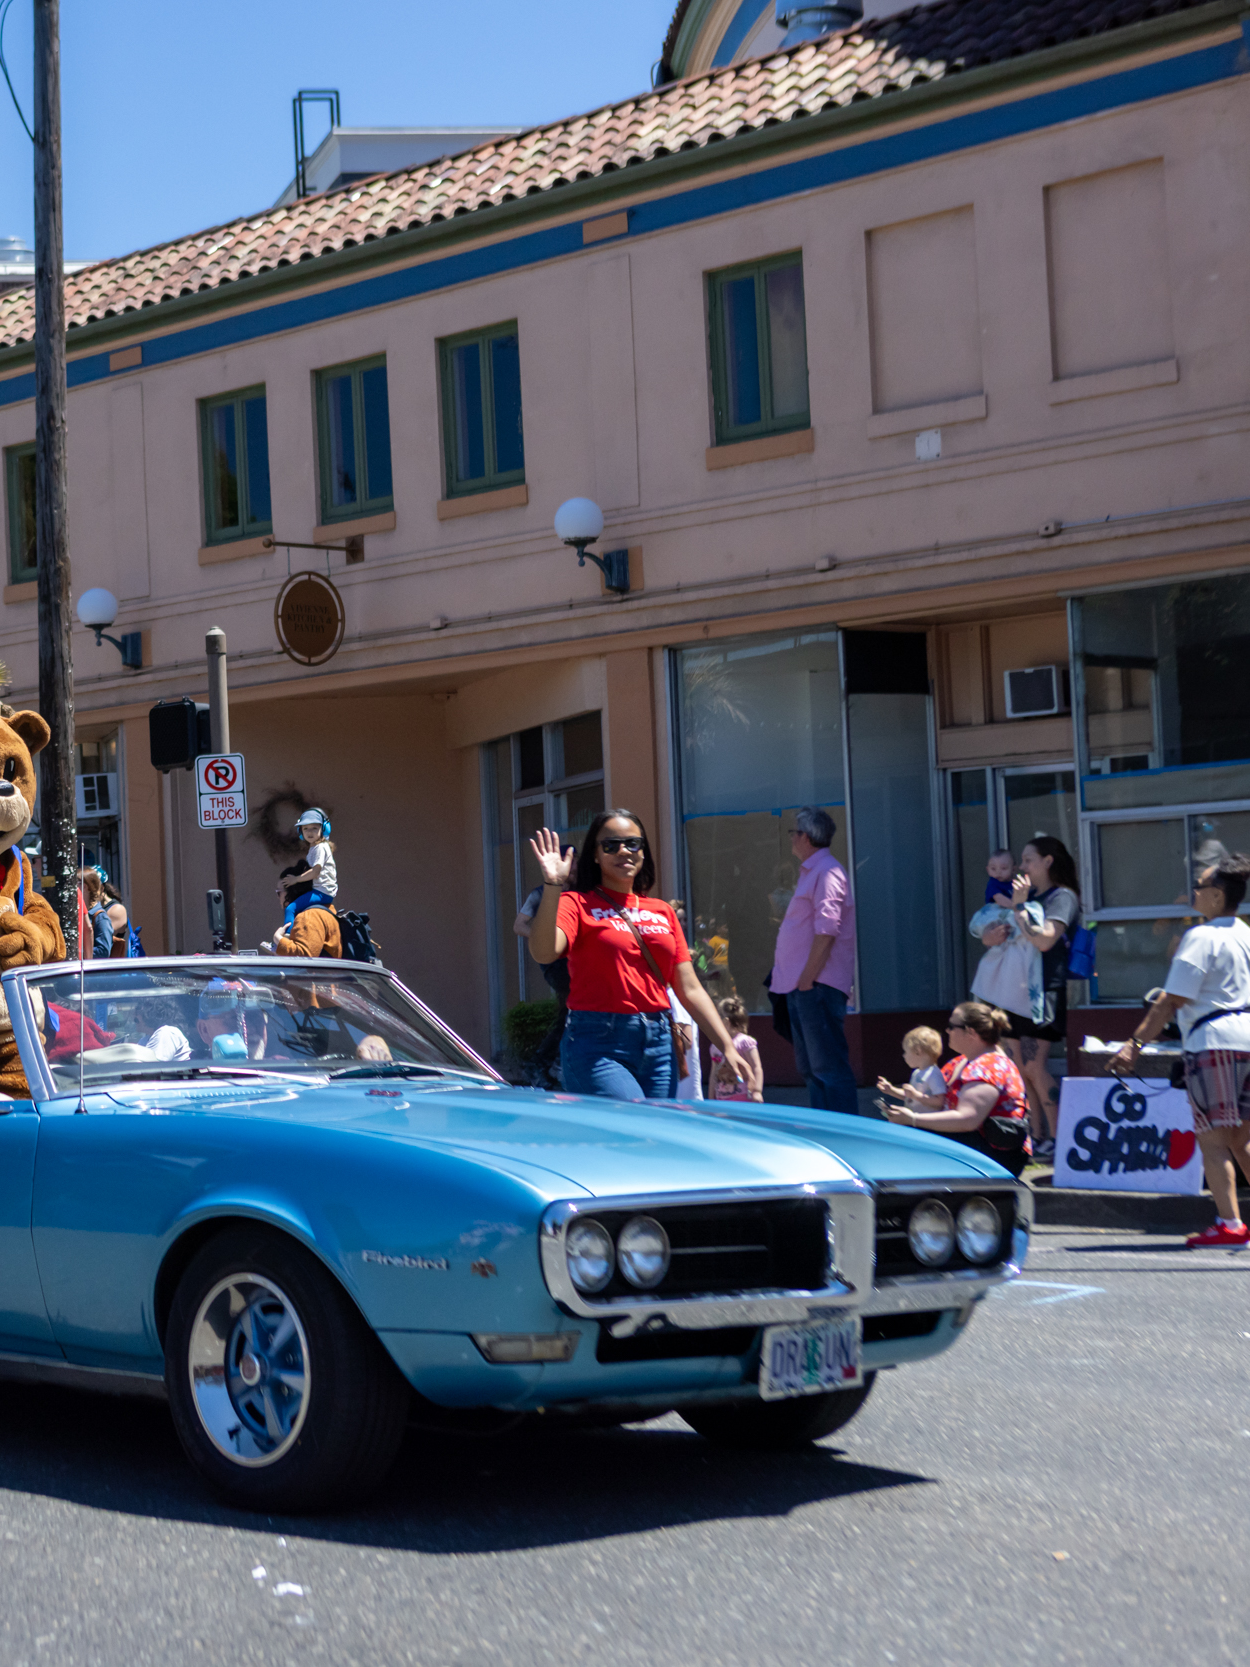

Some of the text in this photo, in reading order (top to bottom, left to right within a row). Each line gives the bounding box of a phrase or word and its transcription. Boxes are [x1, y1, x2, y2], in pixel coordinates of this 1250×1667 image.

[287, 613, 324, 623] KITCHEN
[294, 623, 325, 633] PANTRY
[209, 796, 235, 809] THIS
[203, 808, 242, 822] BLOCK
[362, 1249, 450, 1271] Firebird
